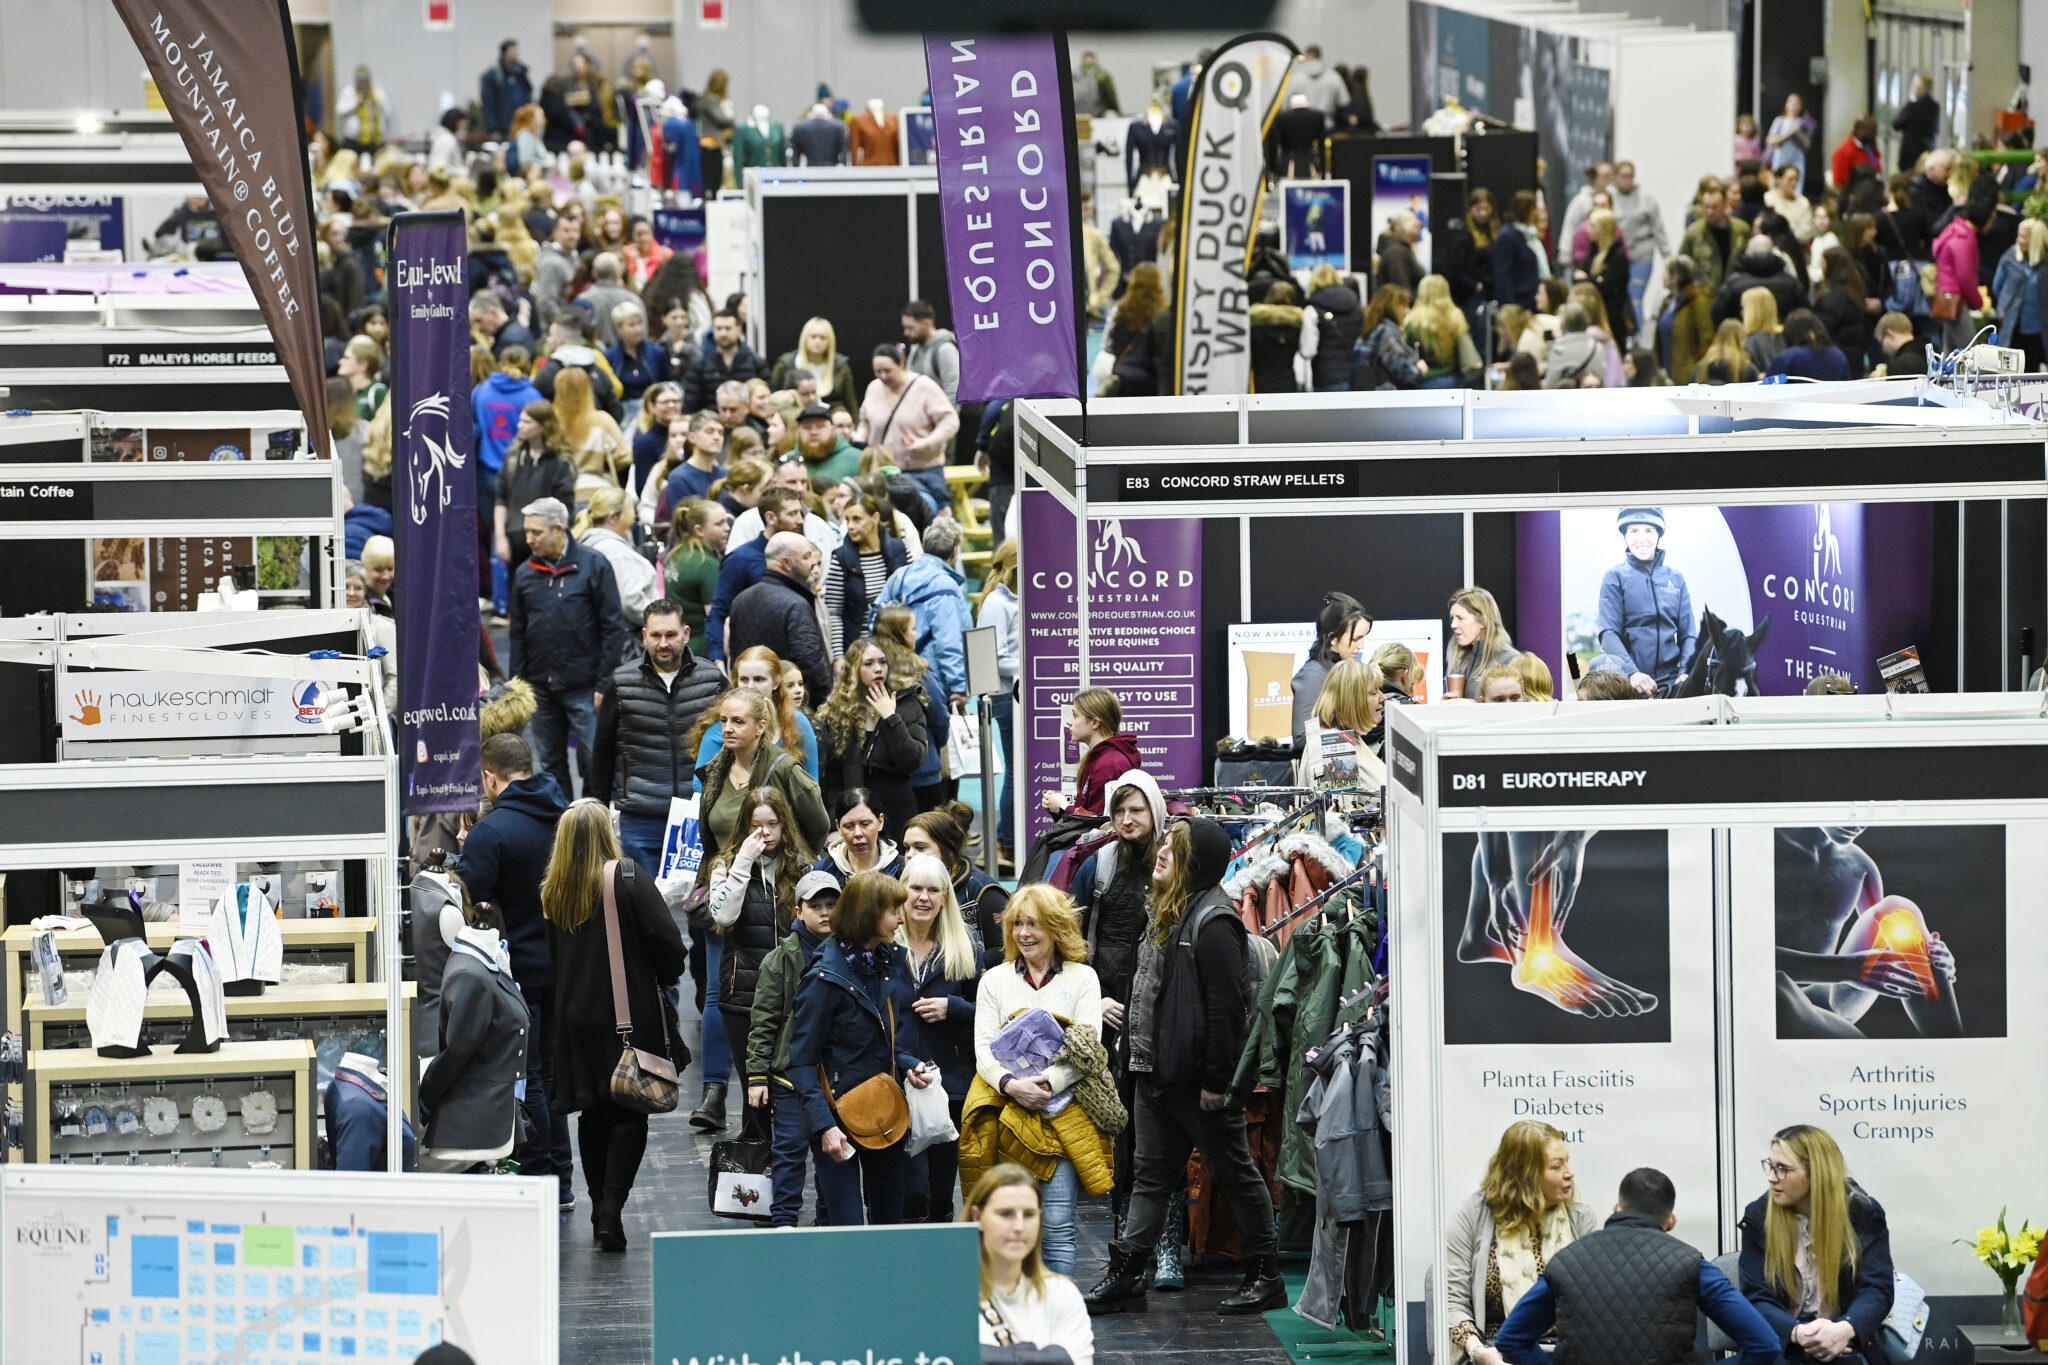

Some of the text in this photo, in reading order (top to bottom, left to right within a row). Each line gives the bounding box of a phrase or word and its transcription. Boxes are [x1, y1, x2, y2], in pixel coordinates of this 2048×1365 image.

[188, 31, 300, 257] JAMAICA BLUE
[1196, 131, 1236, 261] DUCK
[245, 207, 300, 321] COFFEE
[411, 303, 455, 321] Emily Galtry
[108, 352, 277, 365] F72 BAILEYS HORSE FEEDS
[1126, 473, 1345, 489] E83 CONCORD STRAW PELLETS
[0, 485, 75, 498] tain Coffee
[222, 540, 233, 573] ORL
[1031, 570, 1195, 590] CONCORD
[1067, 593, 1160, 604] EUESTRIAN
[1763, 573, 1855, 615] CONCORD
[1794, 609, 1847, 632] EQUESTRIAN
[1030, 626, 1196, 637] THE ALTERATIVE BEDDING CHOICE
[1265, 629, 1317, 637] AVAILABL
[1089, 638, 1116, 647] YOUR
[1117, 638, 1160, 648] EQUINES
[1112, 661, 1165, 674] QUALITY
[1784, 658, 1813, 680] THE
[109, 688, 275, 708] haukeschmidt
[1050, 692, 1074, 705] QUI
[1135, 691, 1152, 701] TO
[1154, 691, 1178, 702] USE
[1452, 770, 1647, 790] D81 EUROTHERAPY
[1482, 1069, 1635, 1088] Planta Fasciitis
[1850, 1065, 1936, 1084] Arthritis
[1513, 1098, 1605, 1116] Diabetes
[1819, 1093, 1968, 1116] Sports Injuries
[1565, 1128, 1586, 1143] ut
[1853, 1121, 1935, 1144] Cramps
[16, 1227, 92, 1247] EQUINE
